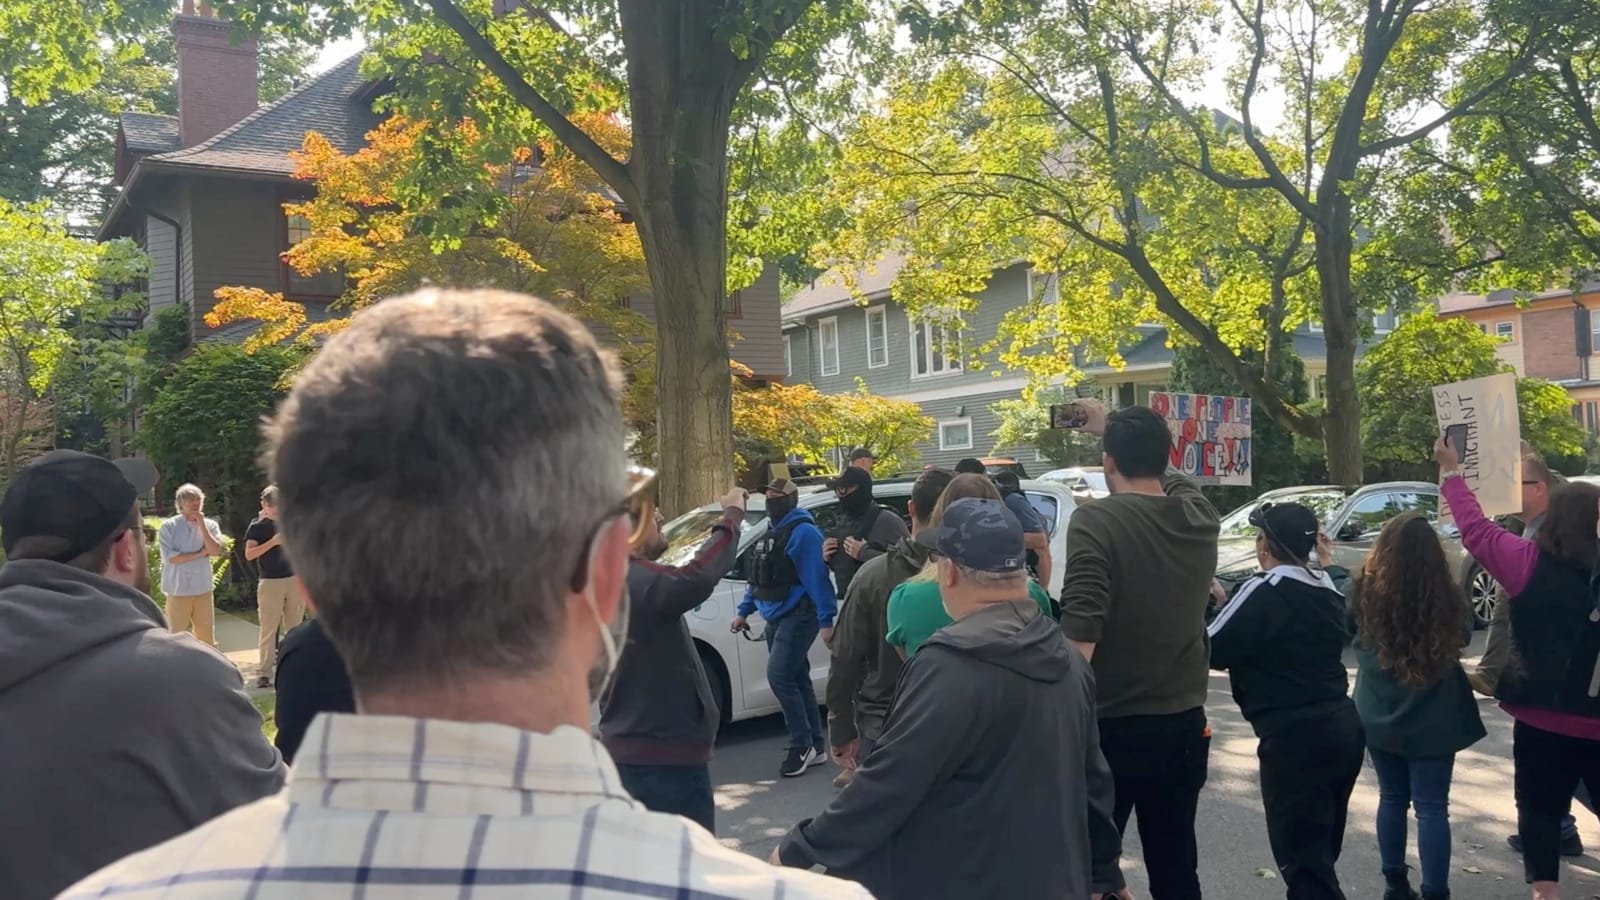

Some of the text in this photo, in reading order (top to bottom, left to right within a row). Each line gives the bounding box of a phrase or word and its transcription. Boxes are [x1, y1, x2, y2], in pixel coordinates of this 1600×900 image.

[1151, 392, 1250, 425] ONE PEOPLE
[1182, 417, 1220, 443] ONE
